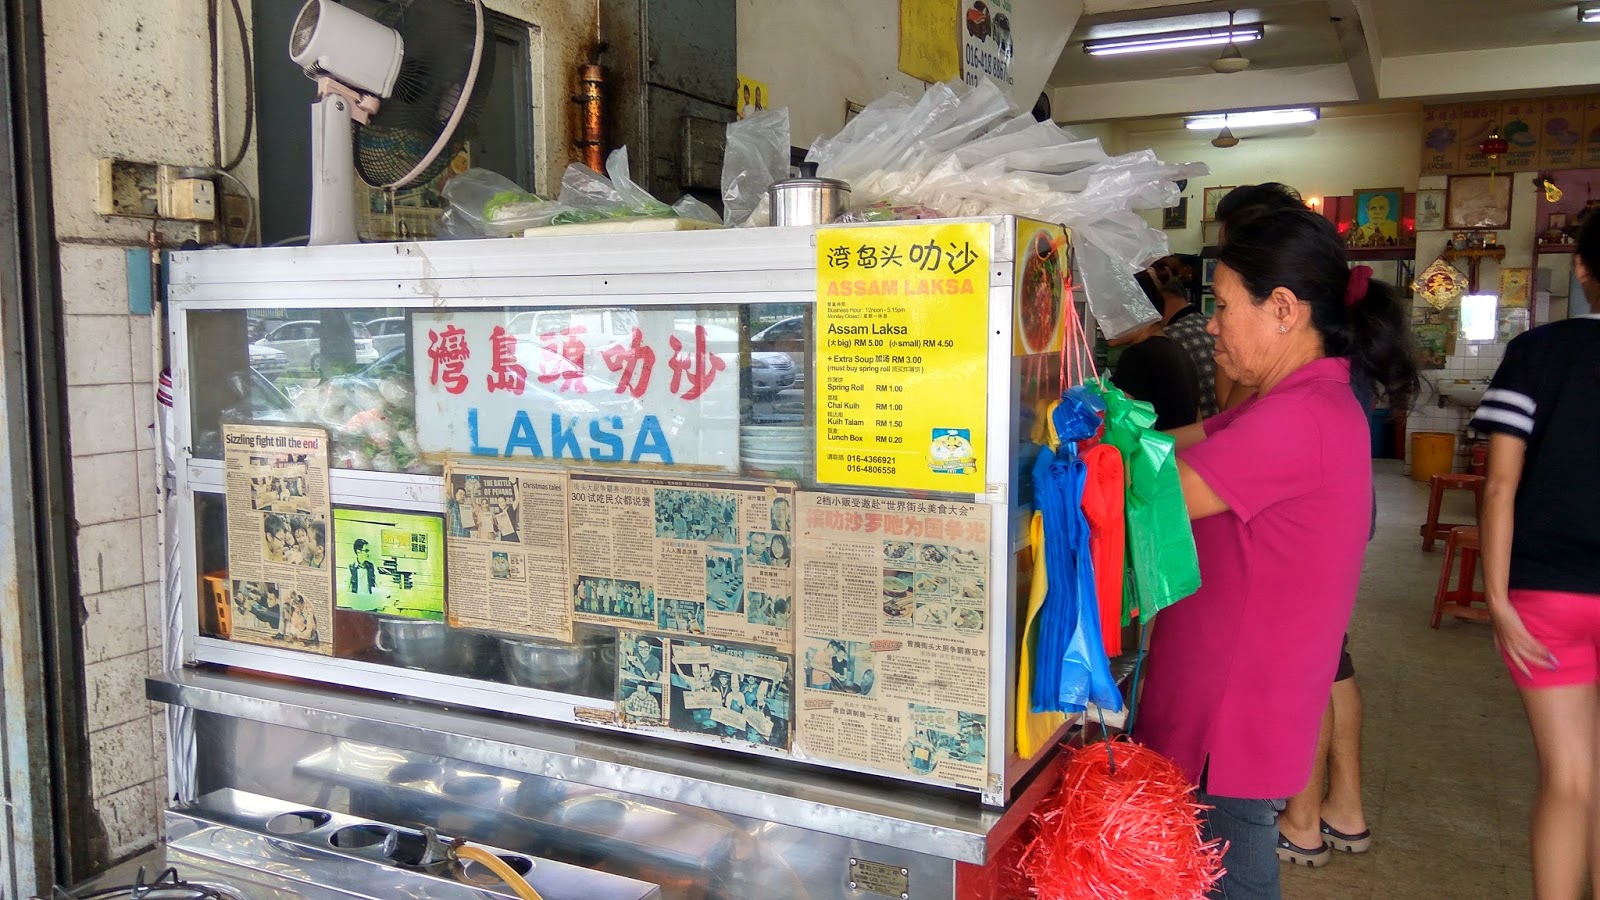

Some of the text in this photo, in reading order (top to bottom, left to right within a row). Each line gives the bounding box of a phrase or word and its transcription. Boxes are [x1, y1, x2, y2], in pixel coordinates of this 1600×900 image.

[827, 239, 978, 274] 湾岛头叻沙
[827, 278, 974, 296] ASSAM LAKSA
[828, 322, 908, 335] Assam Laksa
[854, 339, 866, 347] RM
[868, 339, 884, 347] 5.00
[922, 340, 936, 348] RM
[937, 340, 954, 348] 4.50
[428, 324, 726, 400] 灣島頭叻沙
[854, 356, 874, 365] Soup
[906, 356, 922, 364] 3.00
[847, 366, 858, 374] buy
[859, 366, 879, 374] spring
[827, 384, 850, 392] Spring
[876, 384, 888, 392] RM
[844, 402, 860, 410] Kuih
[827, 418, 843, 426] Kuih
[889, 420, 903, 428] 1.50
[467, 407, 675, 465] LAKSA
[888, 436, 903, 444] 0.20
[226, 434, 319, 449] Sizzling fight till the end
[847, 455, 896, 464] 016-4366921
[847, 464, 896, 475] 016-4806558
[523, 482, 548, 490] Christmas
[571, 493, 651, 507] 300 试吃民众都说赞
